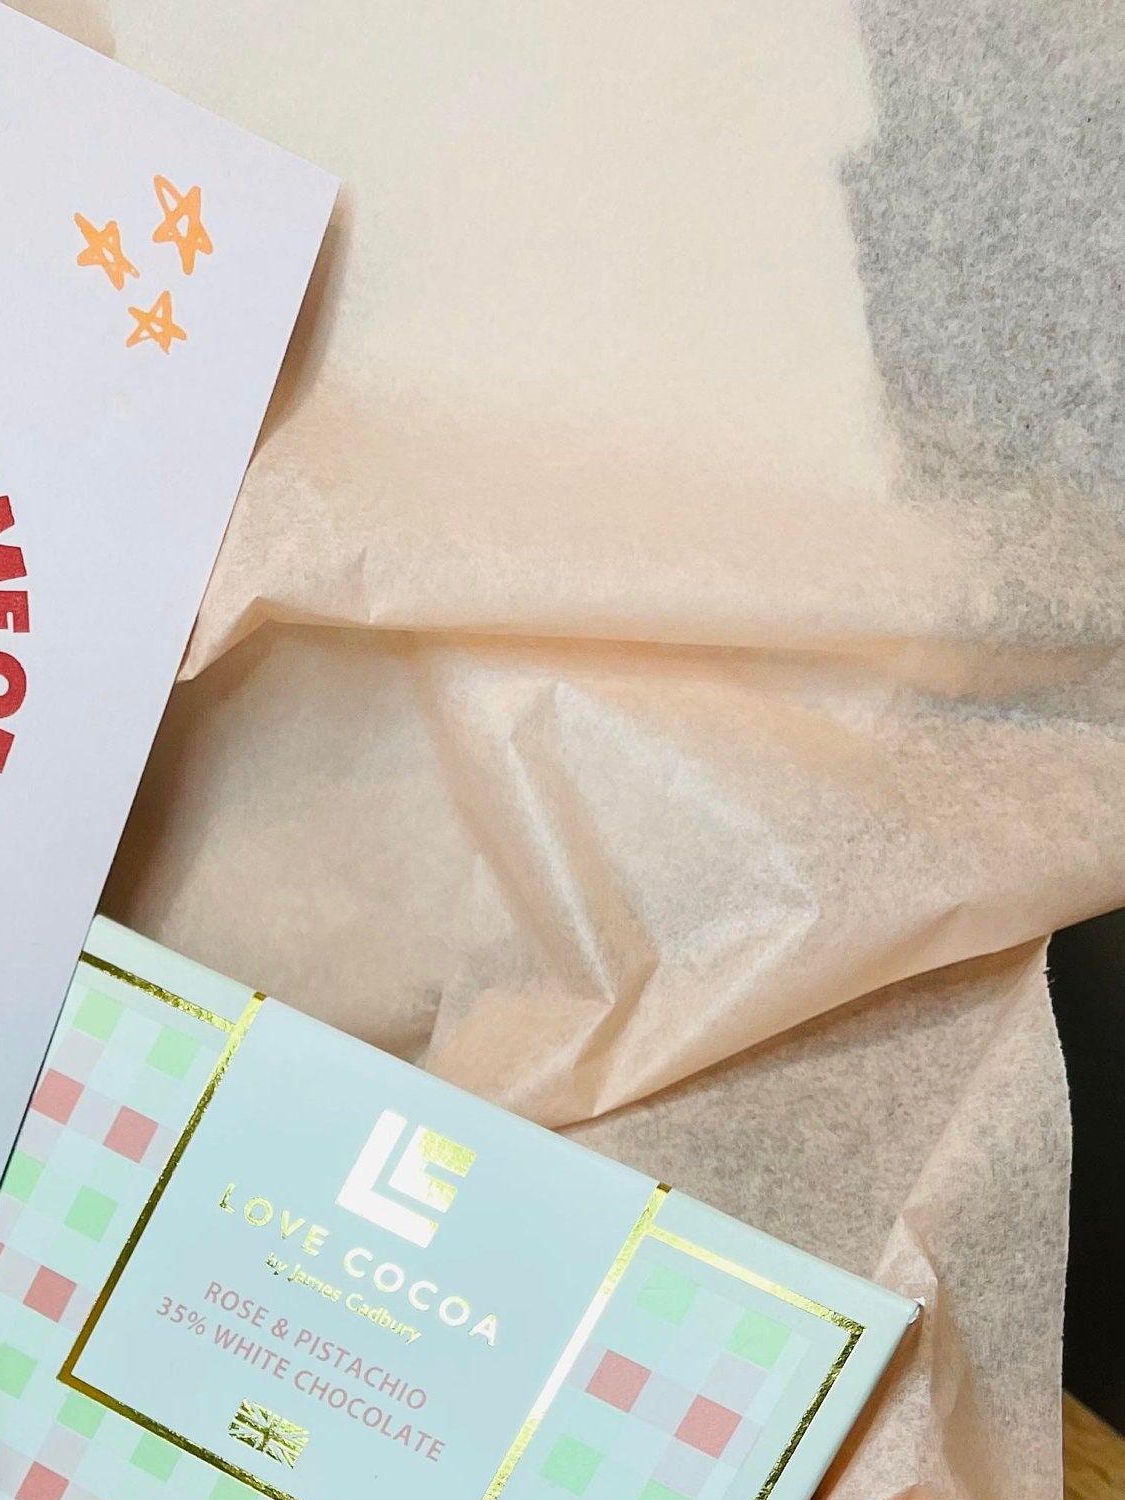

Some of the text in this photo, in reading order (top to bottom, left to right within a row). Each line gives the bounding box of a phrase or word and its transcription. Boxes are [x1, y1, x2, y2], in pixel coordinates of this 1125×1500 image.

[219, 1183, 498, 1347] LOVE COCOA
[287, 1263, 342, 1303] James
[345, 1293, 422, 1345] Cadbury
[155, 1296, 446, 1462] 35% WHITE CHOCOLATE
[204, 1281, 427, 1410] ROSE & PISTACHIO
